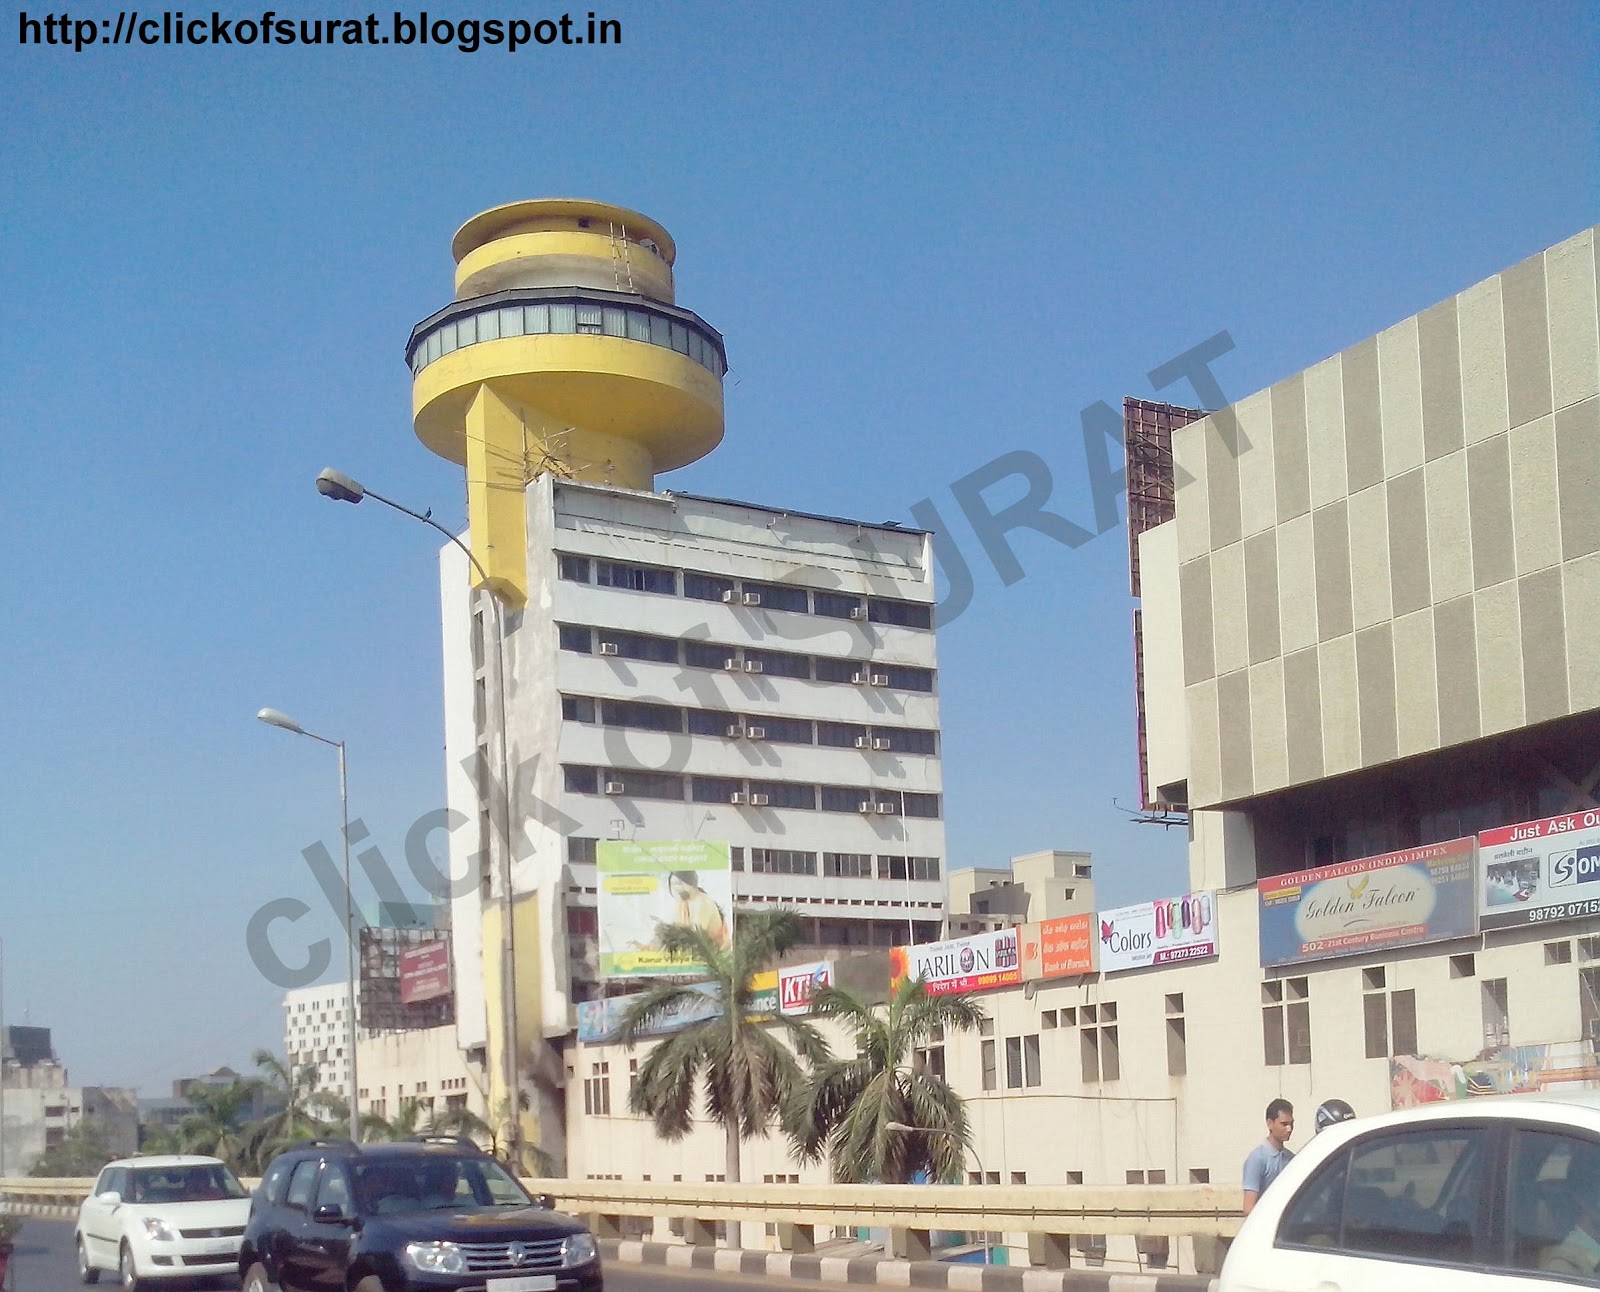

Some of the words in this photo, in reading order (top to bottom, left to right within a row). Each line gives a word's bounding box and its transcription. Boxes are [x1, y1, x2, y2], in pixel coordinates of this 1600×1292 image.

[1510, 824, 1540, 841] Just
[1547, 817, 1576, 834] Ask
[1280, 871, 1322, 886] GOLDEN
[1324, 863, 1366, 878] FALCON
[1368, 854, 1408, 869] (INDIA)
[1411, 846, 1447, 860] IMPEX
[1306, 896, 1354, 919] Golden
[1363, 884, 1415, 909] Falcon
[1529, 906, 1565, 921] 98792
[1110, 929, 1152, 953] Colors
